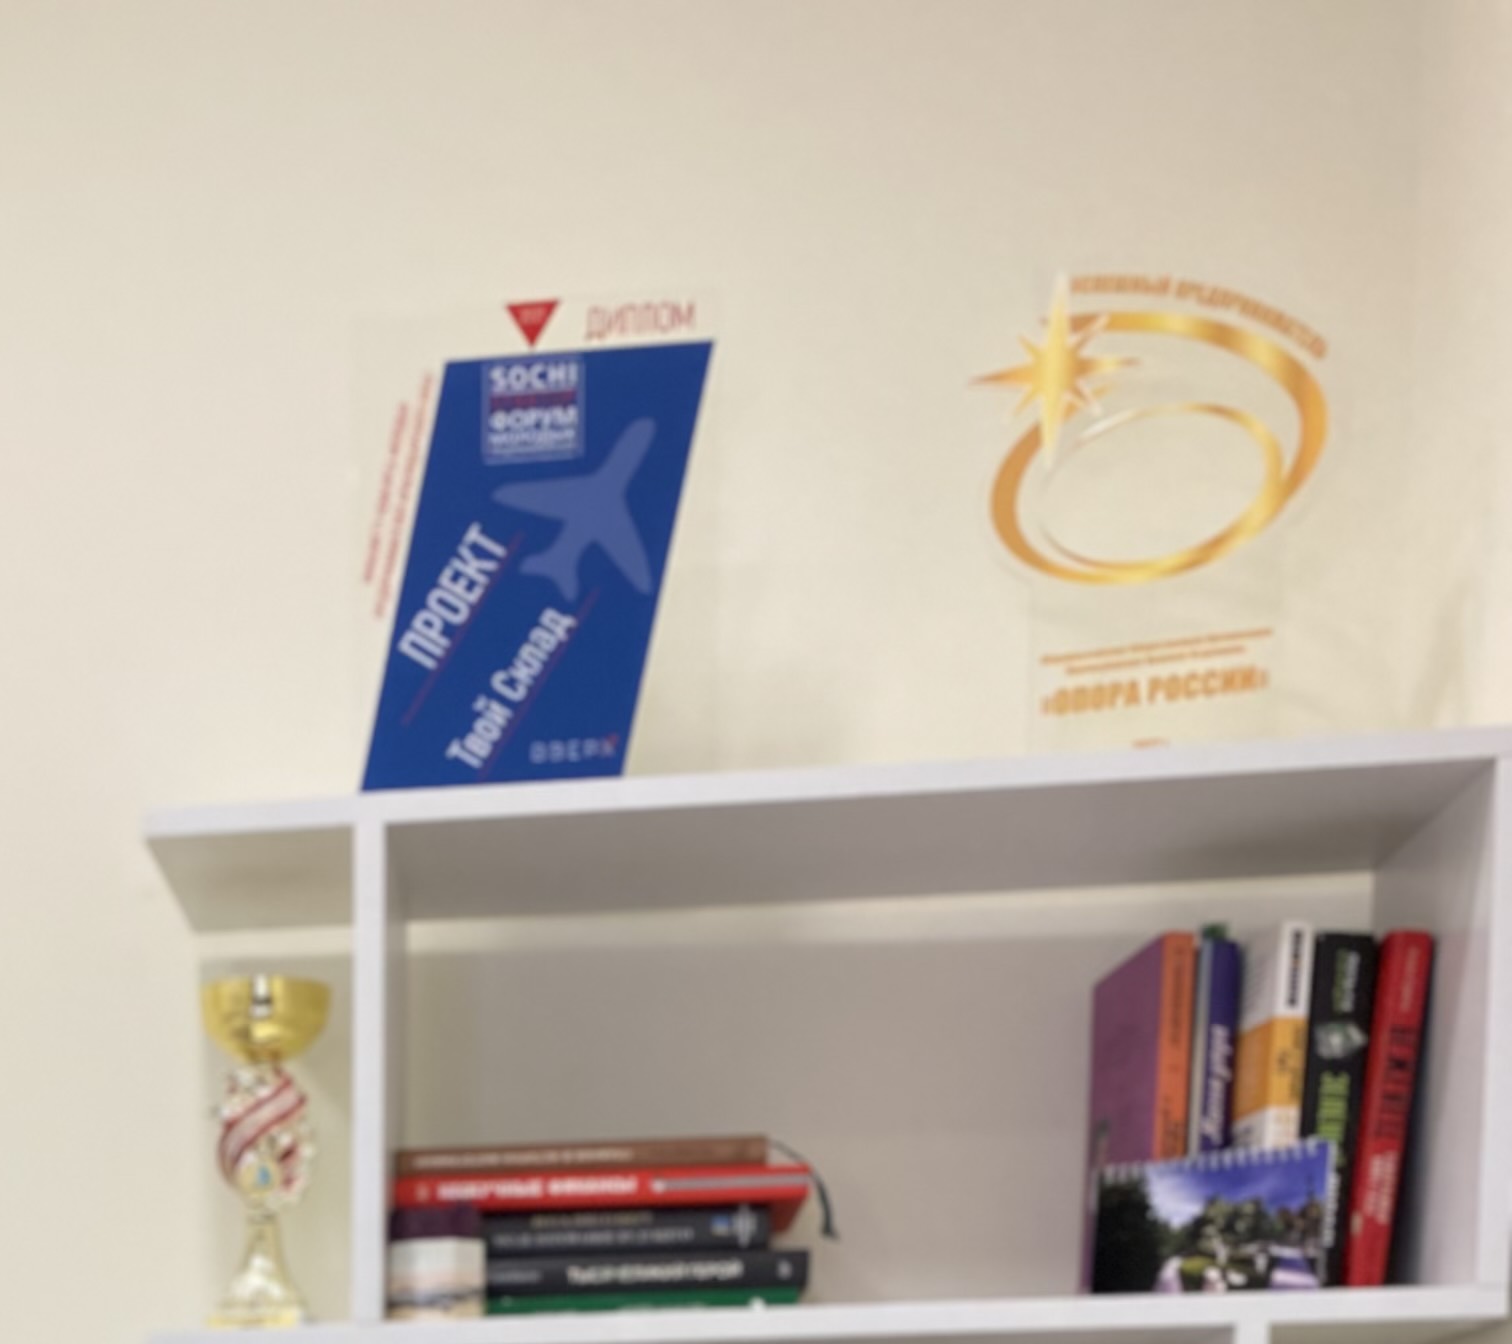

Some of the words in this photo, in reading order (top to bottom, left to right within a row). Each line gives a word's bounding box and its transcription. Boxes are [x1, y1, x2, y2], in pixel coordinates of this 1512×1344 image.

[585, 301, 696, 341] ДИПЛОМ
[489, 360, 579, 393] SOCHI
[397, 521, 508, 671] ПРОЕКТ
[445, 694, 514, 770] Твой
[490, 605, 579, 704] Склад
